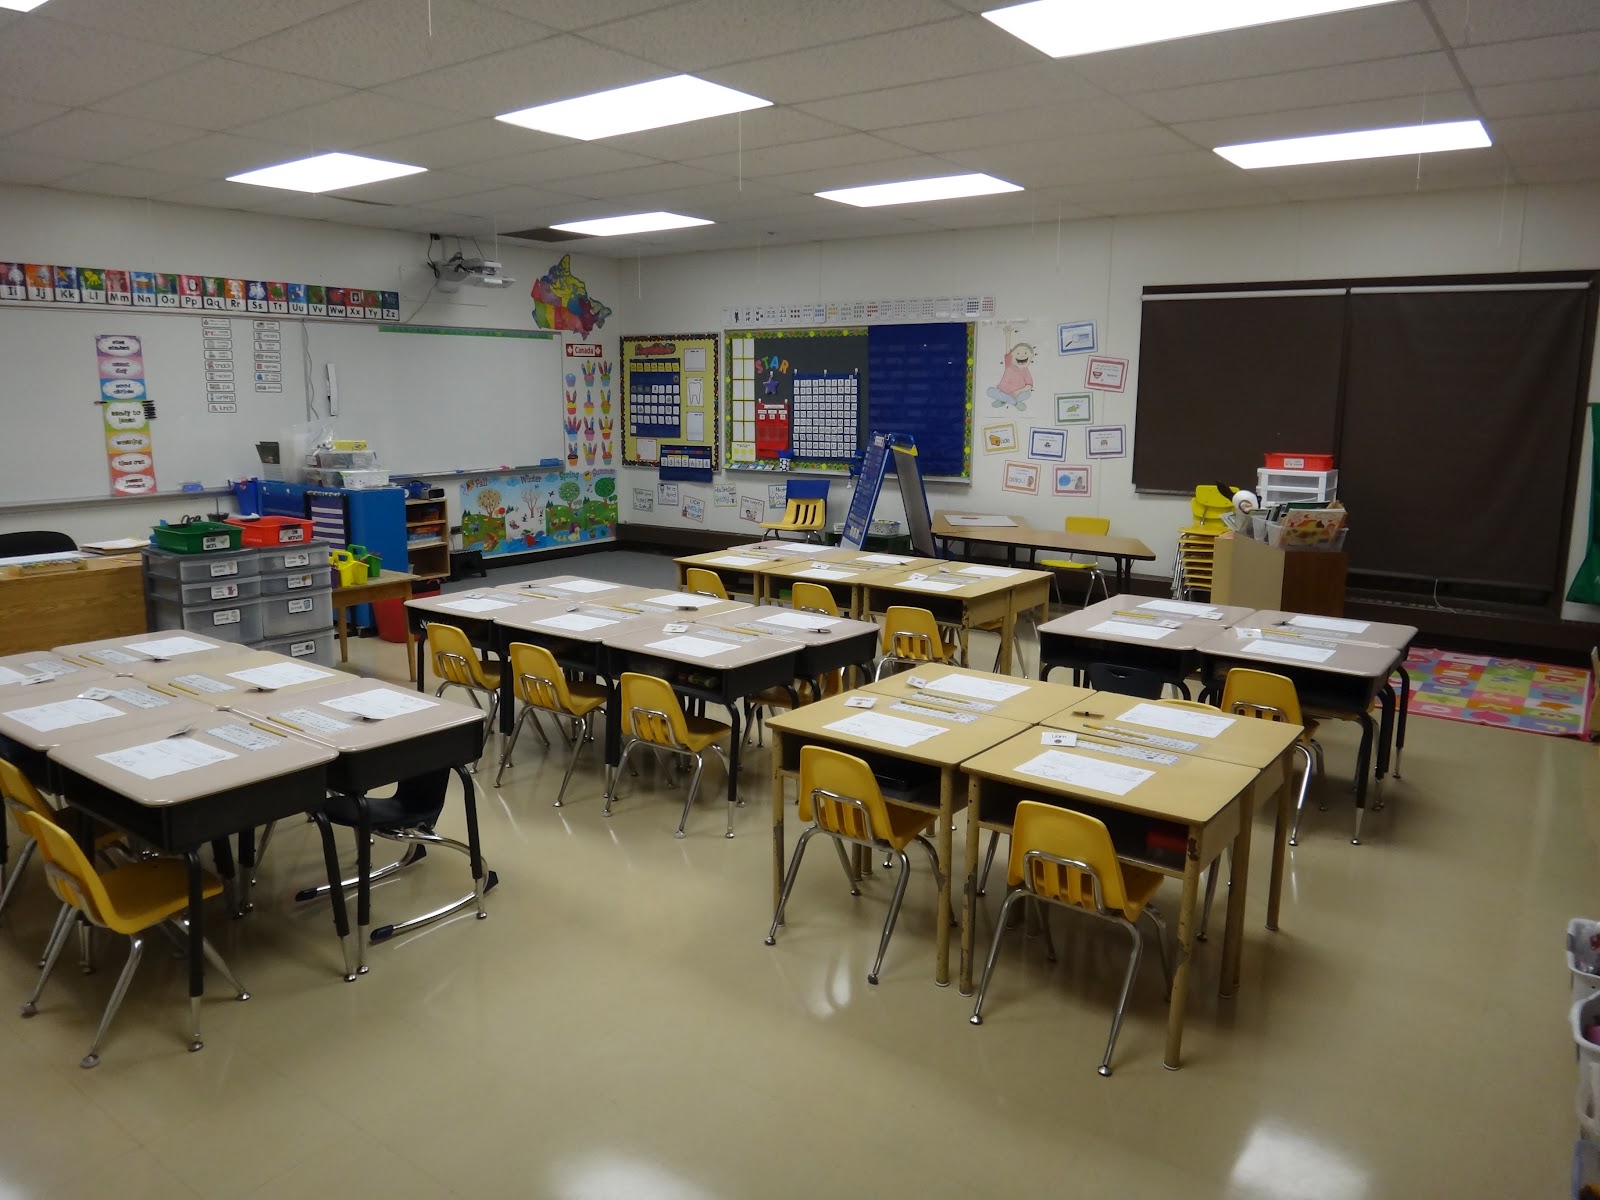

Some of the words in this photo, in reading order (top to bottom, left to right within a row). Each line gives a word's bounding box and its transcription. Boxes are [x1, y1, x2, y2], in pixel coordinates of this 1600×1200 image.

[8, 287, 17, 296] Ii
[35, 289, 46, 300] Jj
[60, 290, 75, 299] Kk
[89, 291, 99, 300] Ll
[110, 293, 129, 302] Mm
[137, 294, 151, 303] Nn
[161, 296, 175, 304] Oo
[185, 297, 197, 306] Pp
[206, 298, 222, 308] Qq
[231, 300, 240, 308] Rr
[252, 301, 263, 310] Ss
[273, 302, 282, 311] Tt
[292, 304, 304, 312] Uu
[312, 305, 324, 313] Vv
[329, 306, 344, 315] Ww
[350, 307, 361, 316] Xx
[369, 309, 378, 318] Yy
[385, 310, 396, 318] Zz
[575, 346, 593, 354] Canada
[756, 356, 789, 374] STAR
[559, 471, 579, 481] Spring
[592, 468, 615, 477] Summer
[475, 478, 488, 488] Fall
[520, 475, 542, 484] Winter
